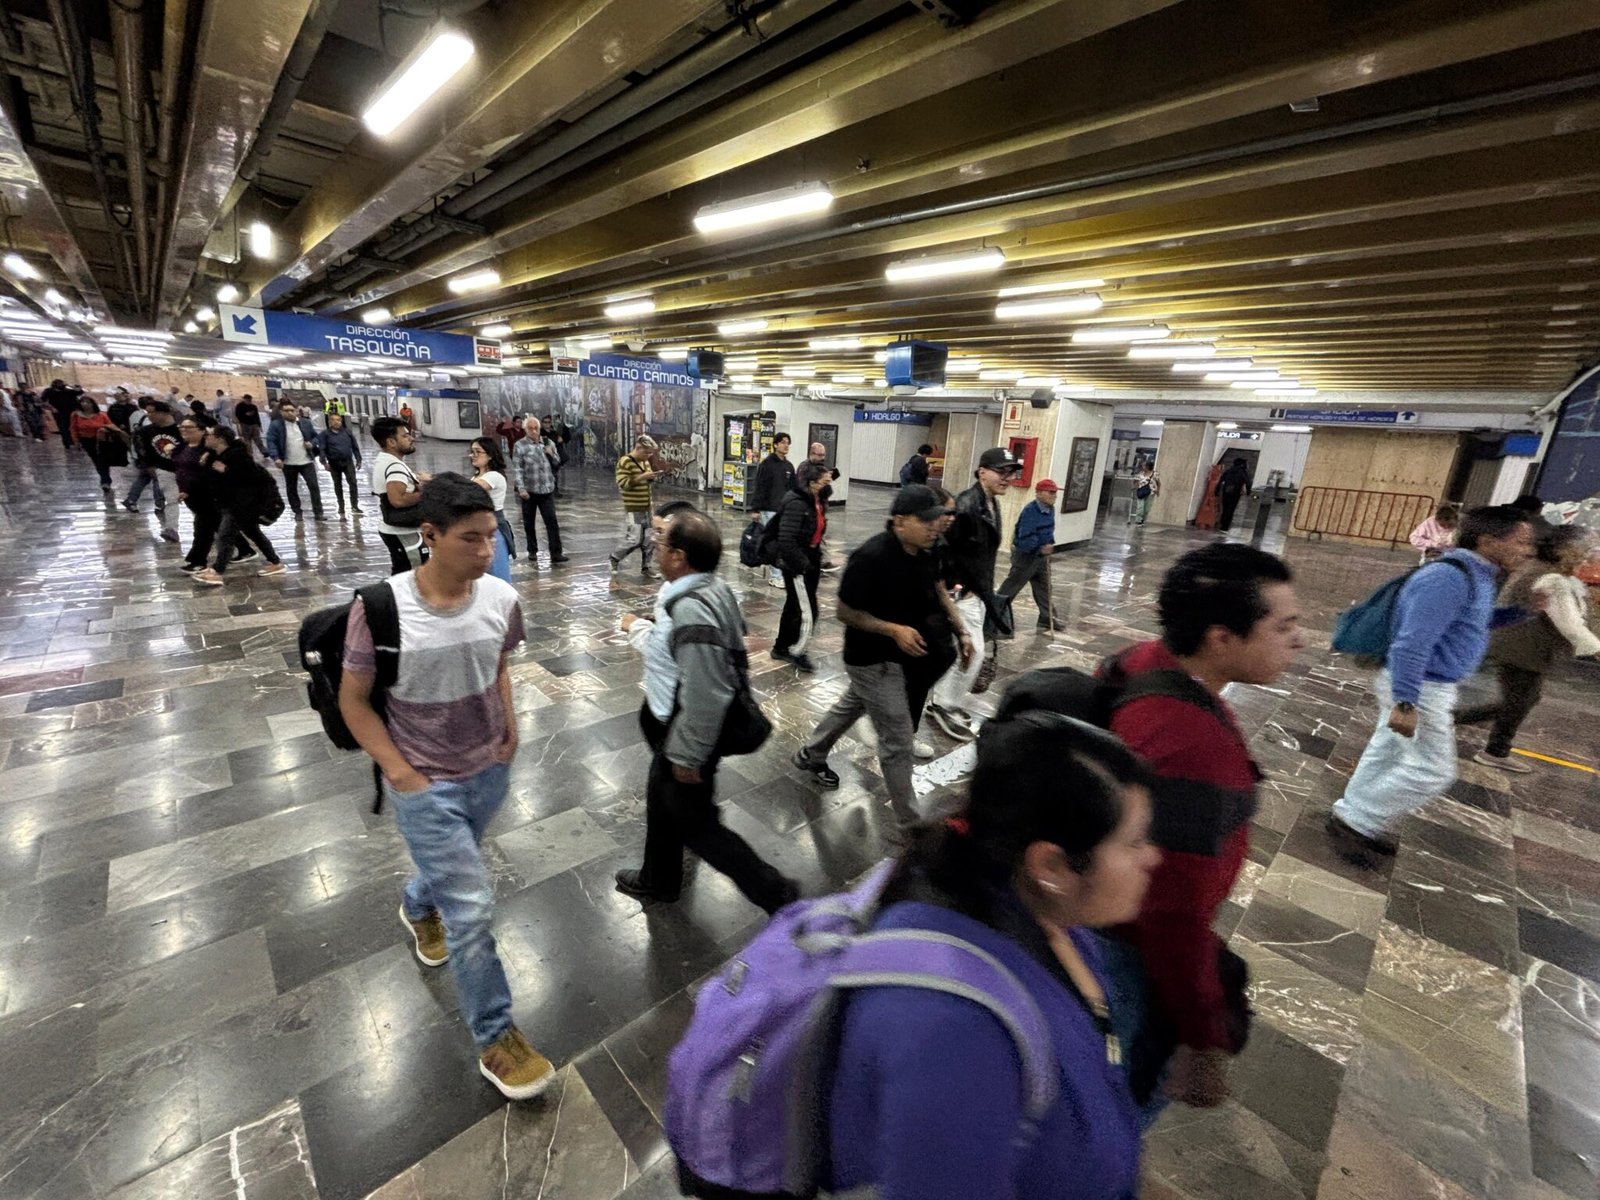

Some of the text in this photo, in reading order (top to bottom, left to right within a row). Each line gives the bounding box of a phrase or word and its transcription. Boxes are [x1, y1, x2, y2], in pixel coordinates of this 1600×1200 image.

[346, 324, 410, 341] DIRECCIÓN
[325, 335, 431, 360] TASQUEÑA
[624, 359, 662, 370] DIRECCIÓN
[588, 363, 694, 386] CUATRO CAMINOS
[871, 412, 901, 421] HIDALGO
